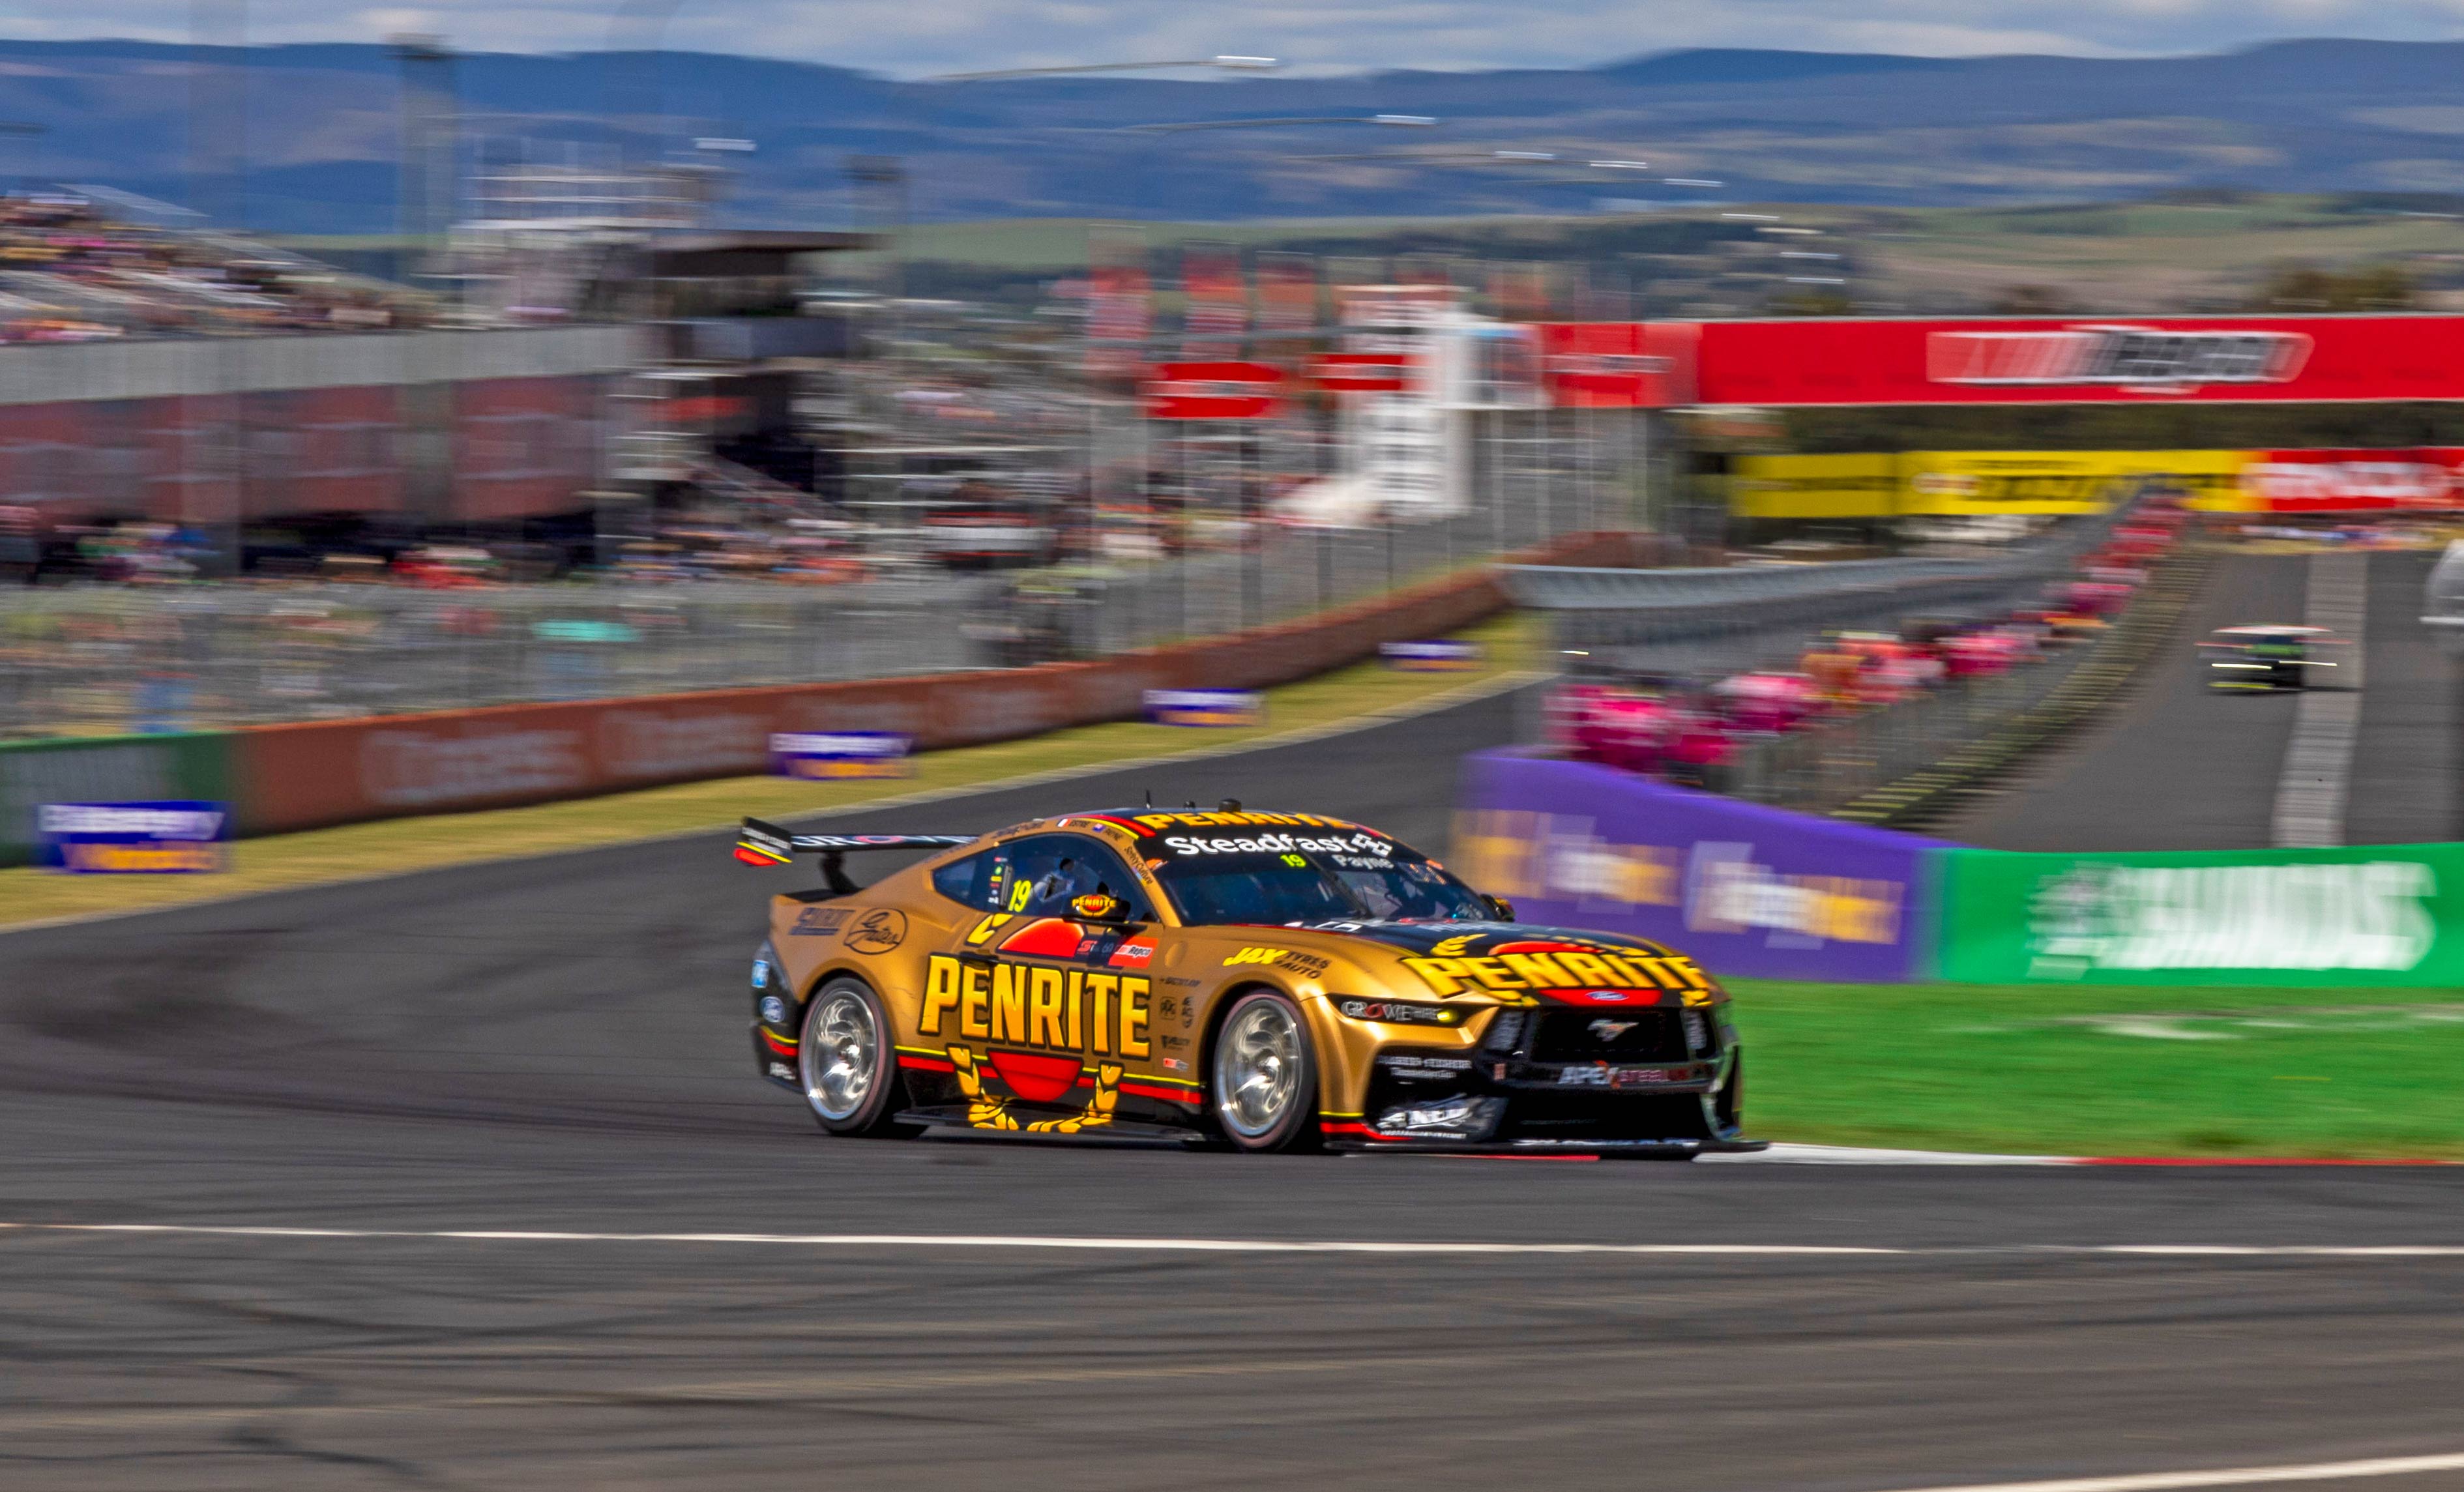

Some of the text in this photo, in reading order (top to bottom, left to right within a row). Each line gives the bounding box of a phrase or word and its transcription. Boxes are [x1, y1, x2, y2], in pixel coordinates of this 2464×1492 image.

[1133, 812, 1357, 830] PENRITE
[1165, 833, 1358, 855] Steadfast
[1280, 855, 1306, 868] 19
[1008, 879, 1031, 913] 19
[1072, 898, 1117, 909] PENRITE
[1128, 946, 1152, 958] Repco
[1222, 947, 1289, 967] JAX
[1284, 951, 1332, 969] TYRES
[1401, 952, 1714, 998] PENRITE
[919, 955, 1151, 1060] PENRITE
